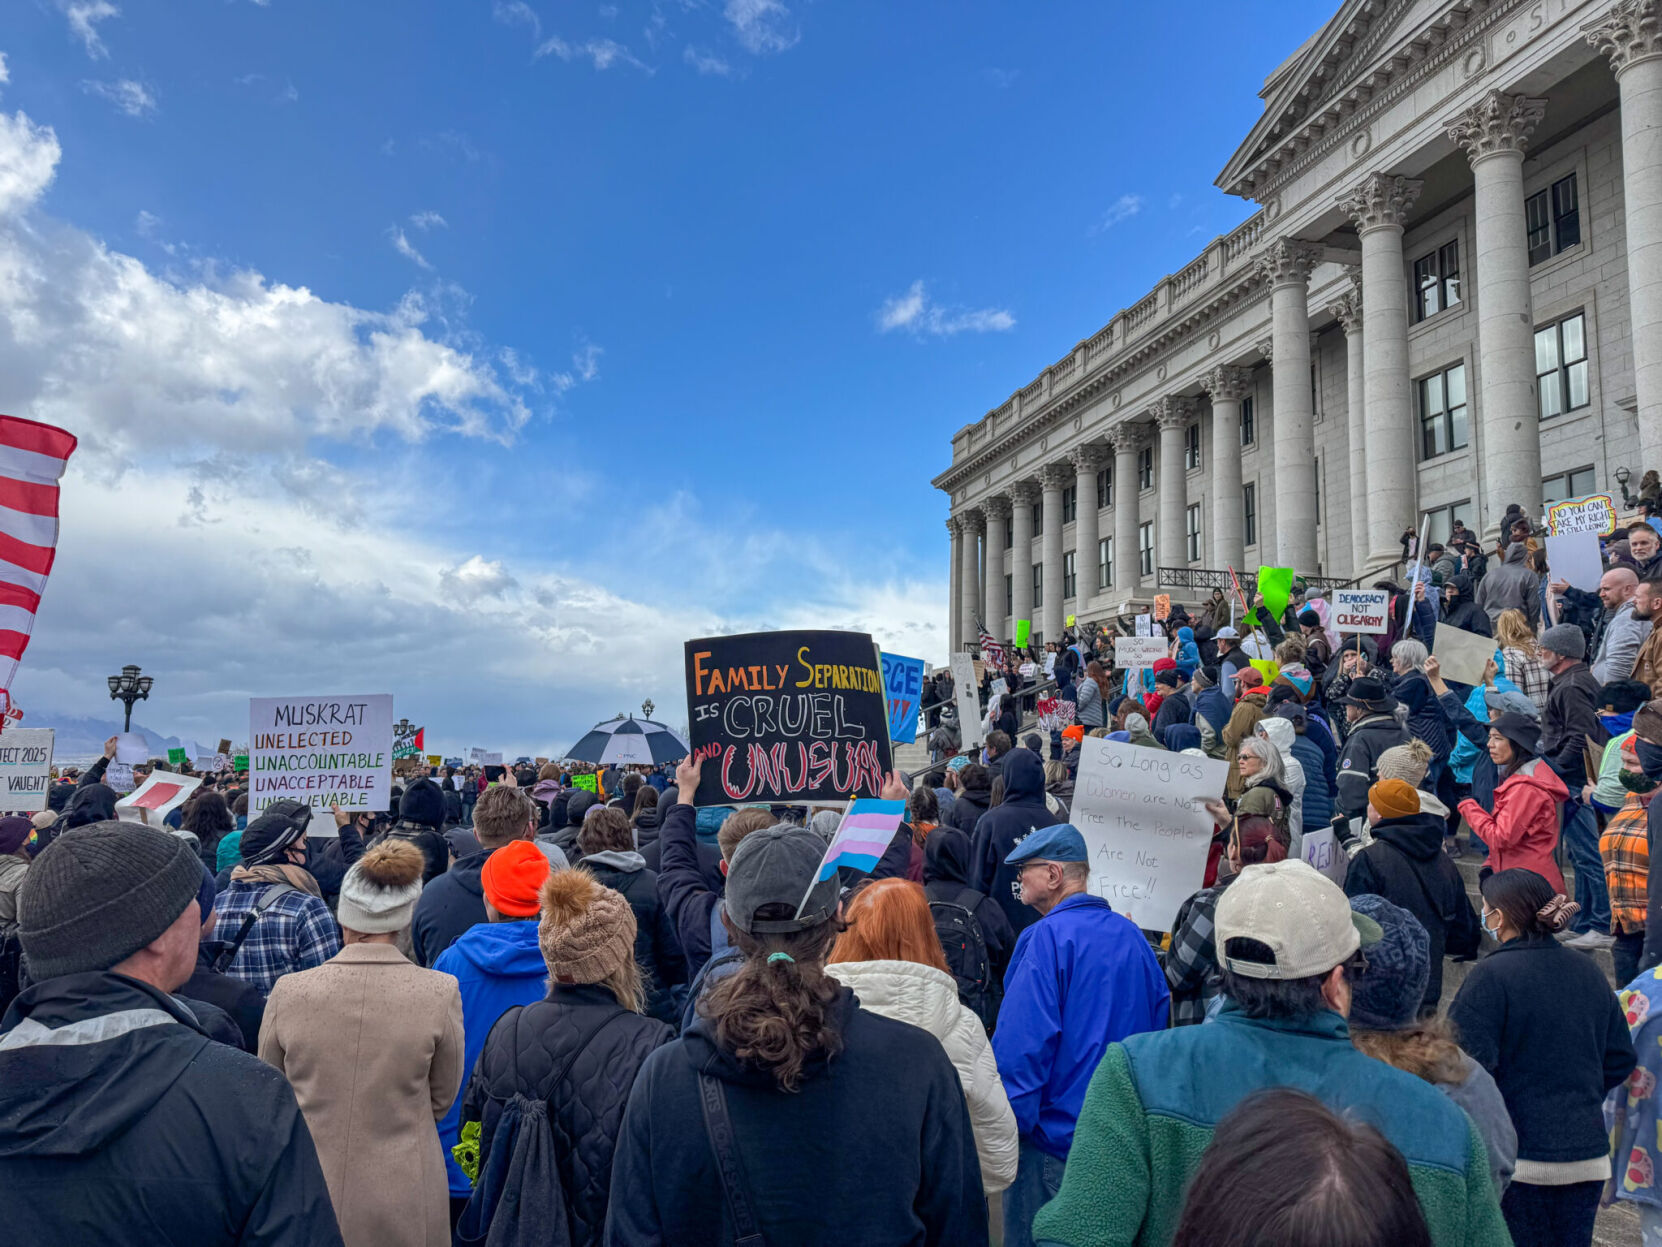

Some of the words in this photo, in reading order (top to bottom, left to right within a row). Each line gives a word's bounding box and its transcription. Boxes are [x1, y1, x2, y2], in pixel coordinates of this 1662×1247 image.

[1550, 517, 1572, 529] TAKE
[1575, 513, 1586, 526] MY
[1553, 508, 1566, 519] NO
[1568, 504, 1585, 516] YOU
[1338, 593, 1385, 604] DEMOCRACY
[1351, 604, 1371, 613] NOT
[694, 651, 790, 696] FAMILY
[795, 646, 882, 694] SEPARATION
[274, 702, 369, 727] MUSKRAT
[694, 702, 720, 722] IS
[723, 693, 866, 739] CRUEL
[255, 730, 353, 750] UNELECTED
[21, 747, 48, 763] 2025
[255, 752, 385, 772] UNACCOUNTABLE
[1130, 750, 1171, 783] Long
[8, 776, 49, 791] VAUGHT
[255, 773, 375, 792] UNACCEPTABLE
[255, 792, 369, 811] UNIEVABLE
[1080, 807, 1105, 824] Free
[1153, 820, 1194, 841] People
[1096, 843, 1124, 861] Are
